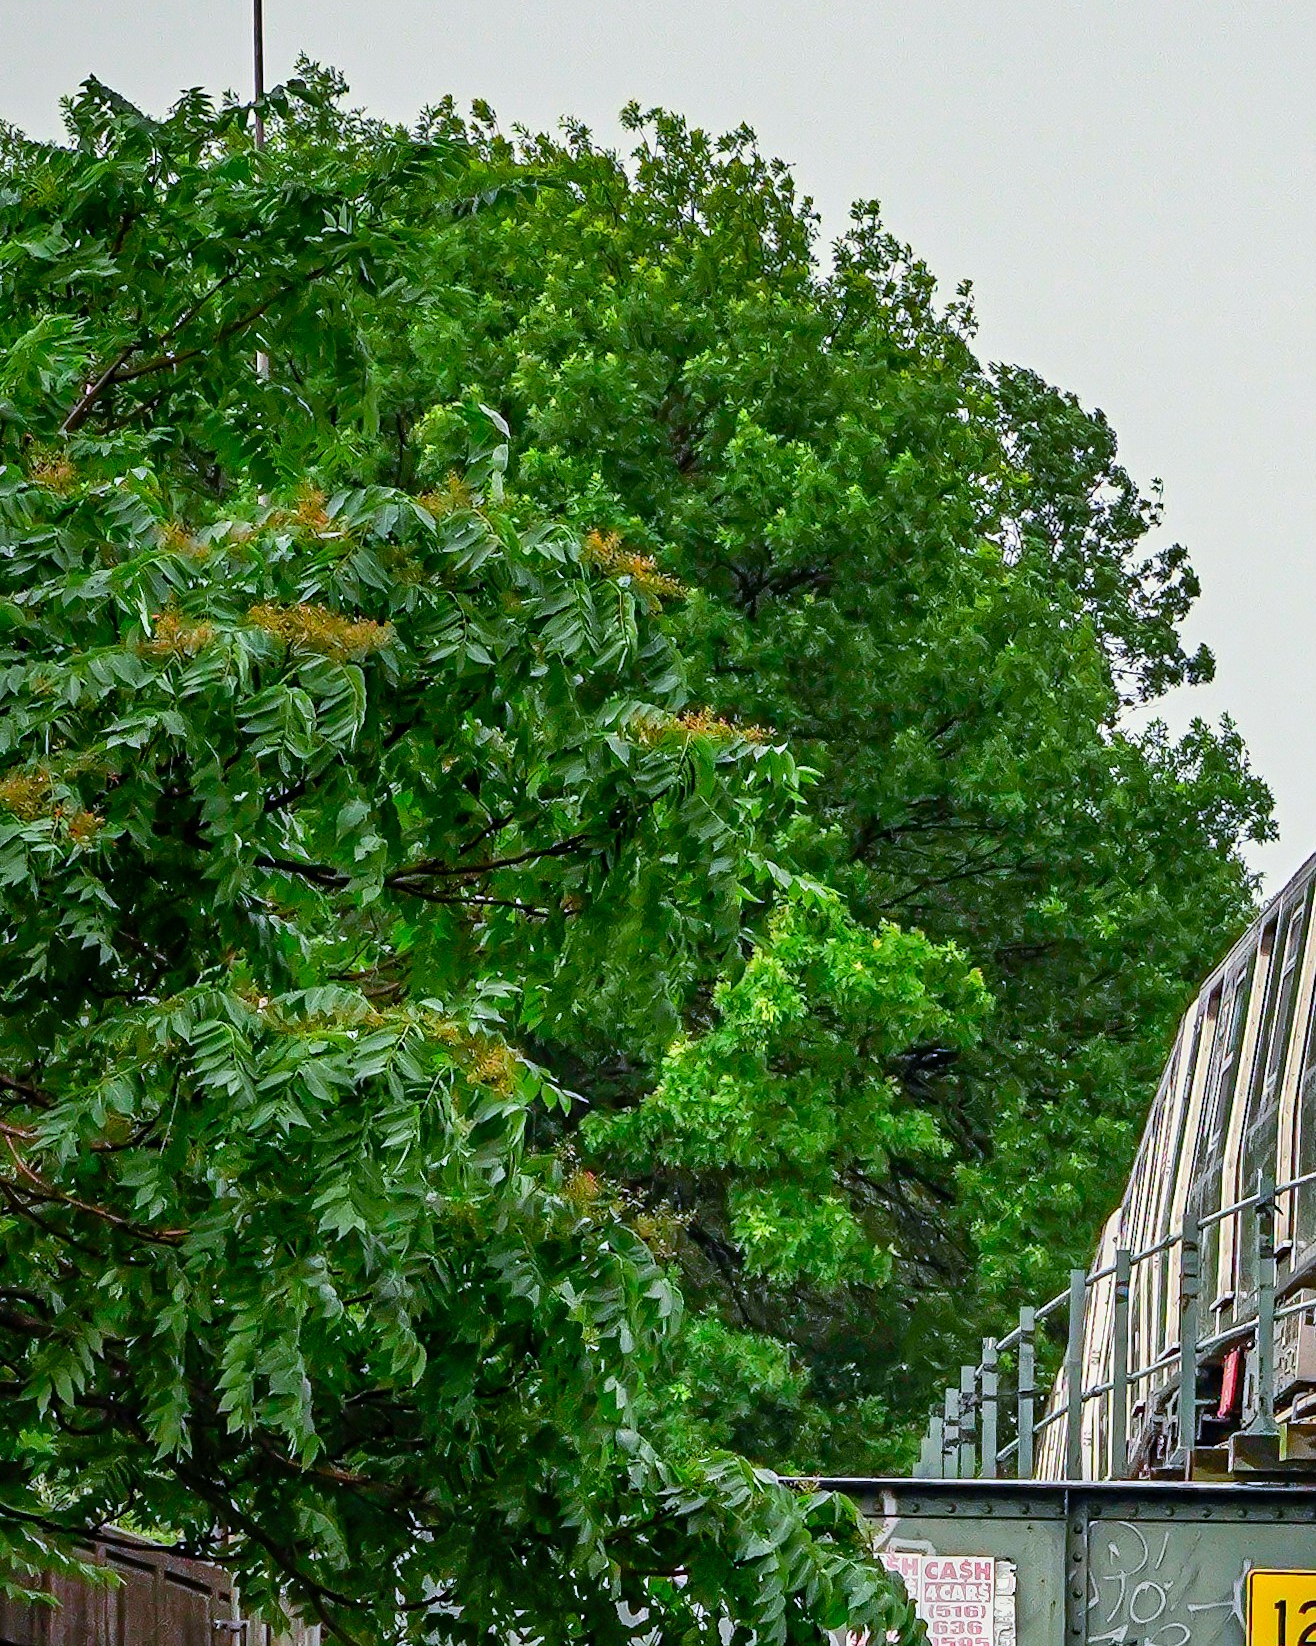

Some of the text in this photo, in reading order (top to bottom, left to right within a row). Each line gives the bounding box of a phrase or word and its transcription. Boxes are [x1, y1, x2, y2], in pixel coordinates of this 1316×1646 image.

[924, 1559, 991, 1582] CA$H
[928, 1605, 987, 1619] (516)
[932, 1621, 983, 1635] 636
